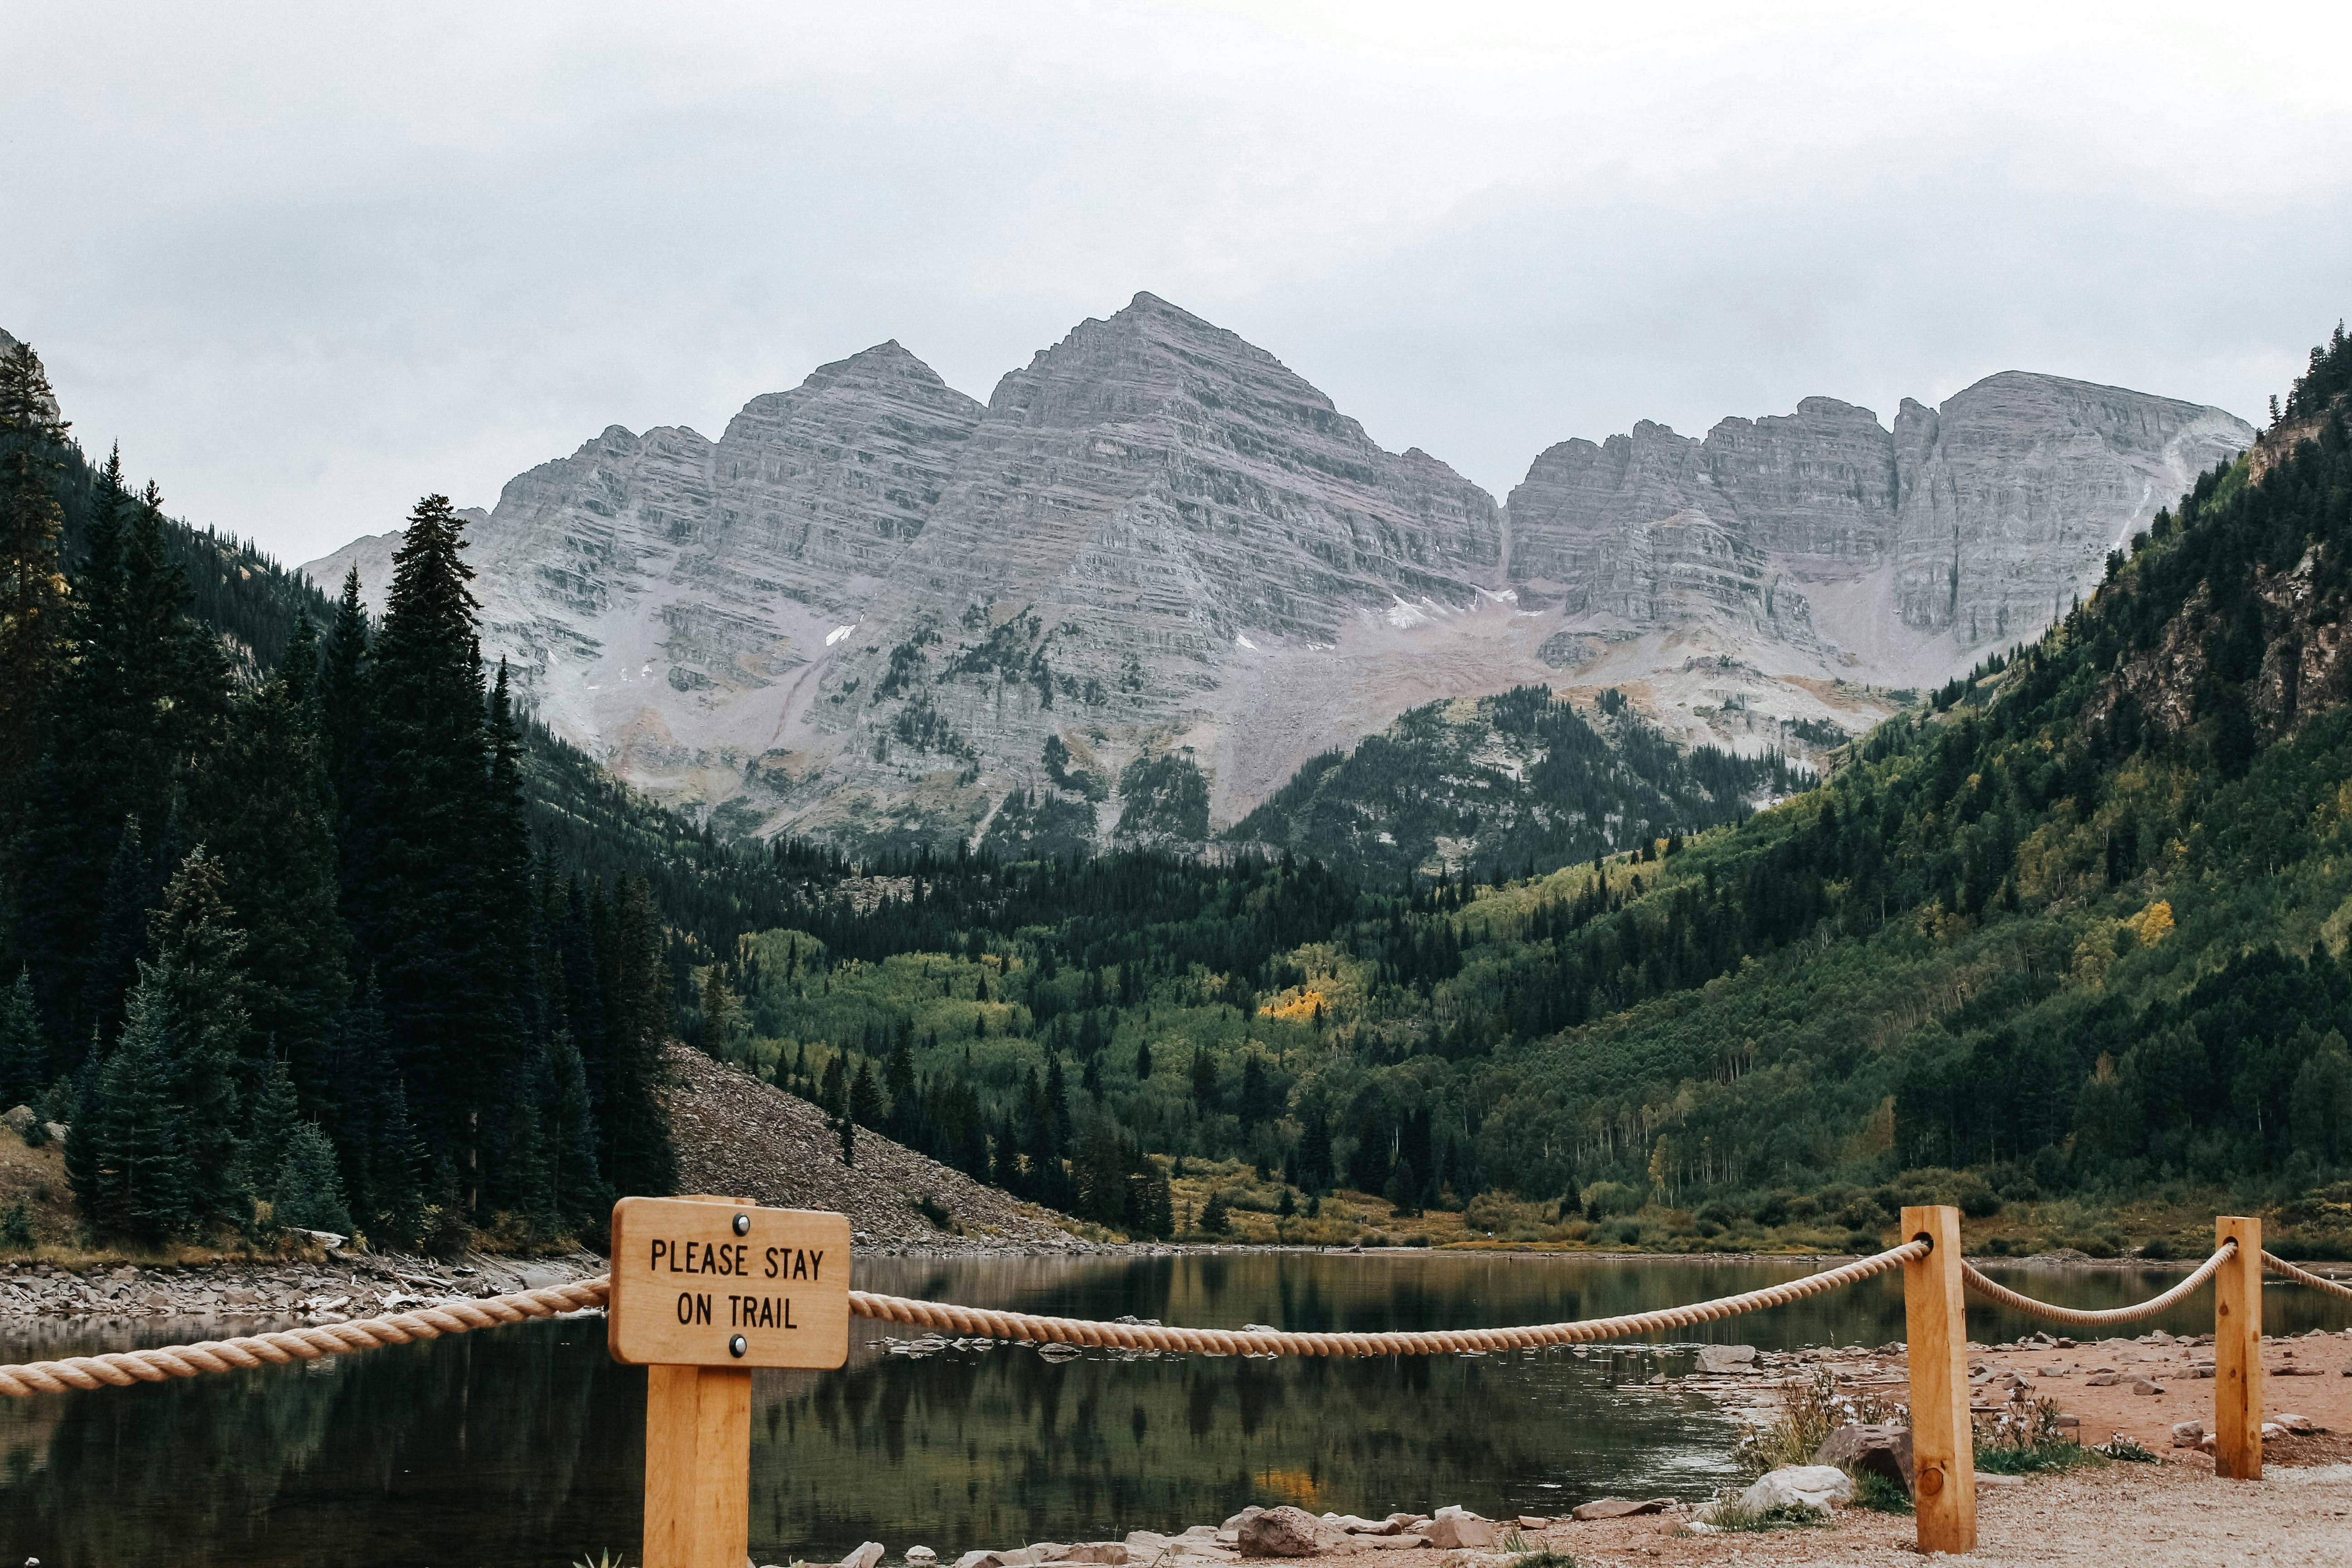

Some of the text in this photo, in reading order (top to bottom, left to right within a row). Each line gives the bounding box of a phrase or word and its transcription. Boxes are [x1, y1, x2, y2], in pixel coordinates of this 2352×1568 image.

[651, 1239, 824, 1281] PLEASE STAY
[677, 1292, 798, 1329] ON TRAIL
